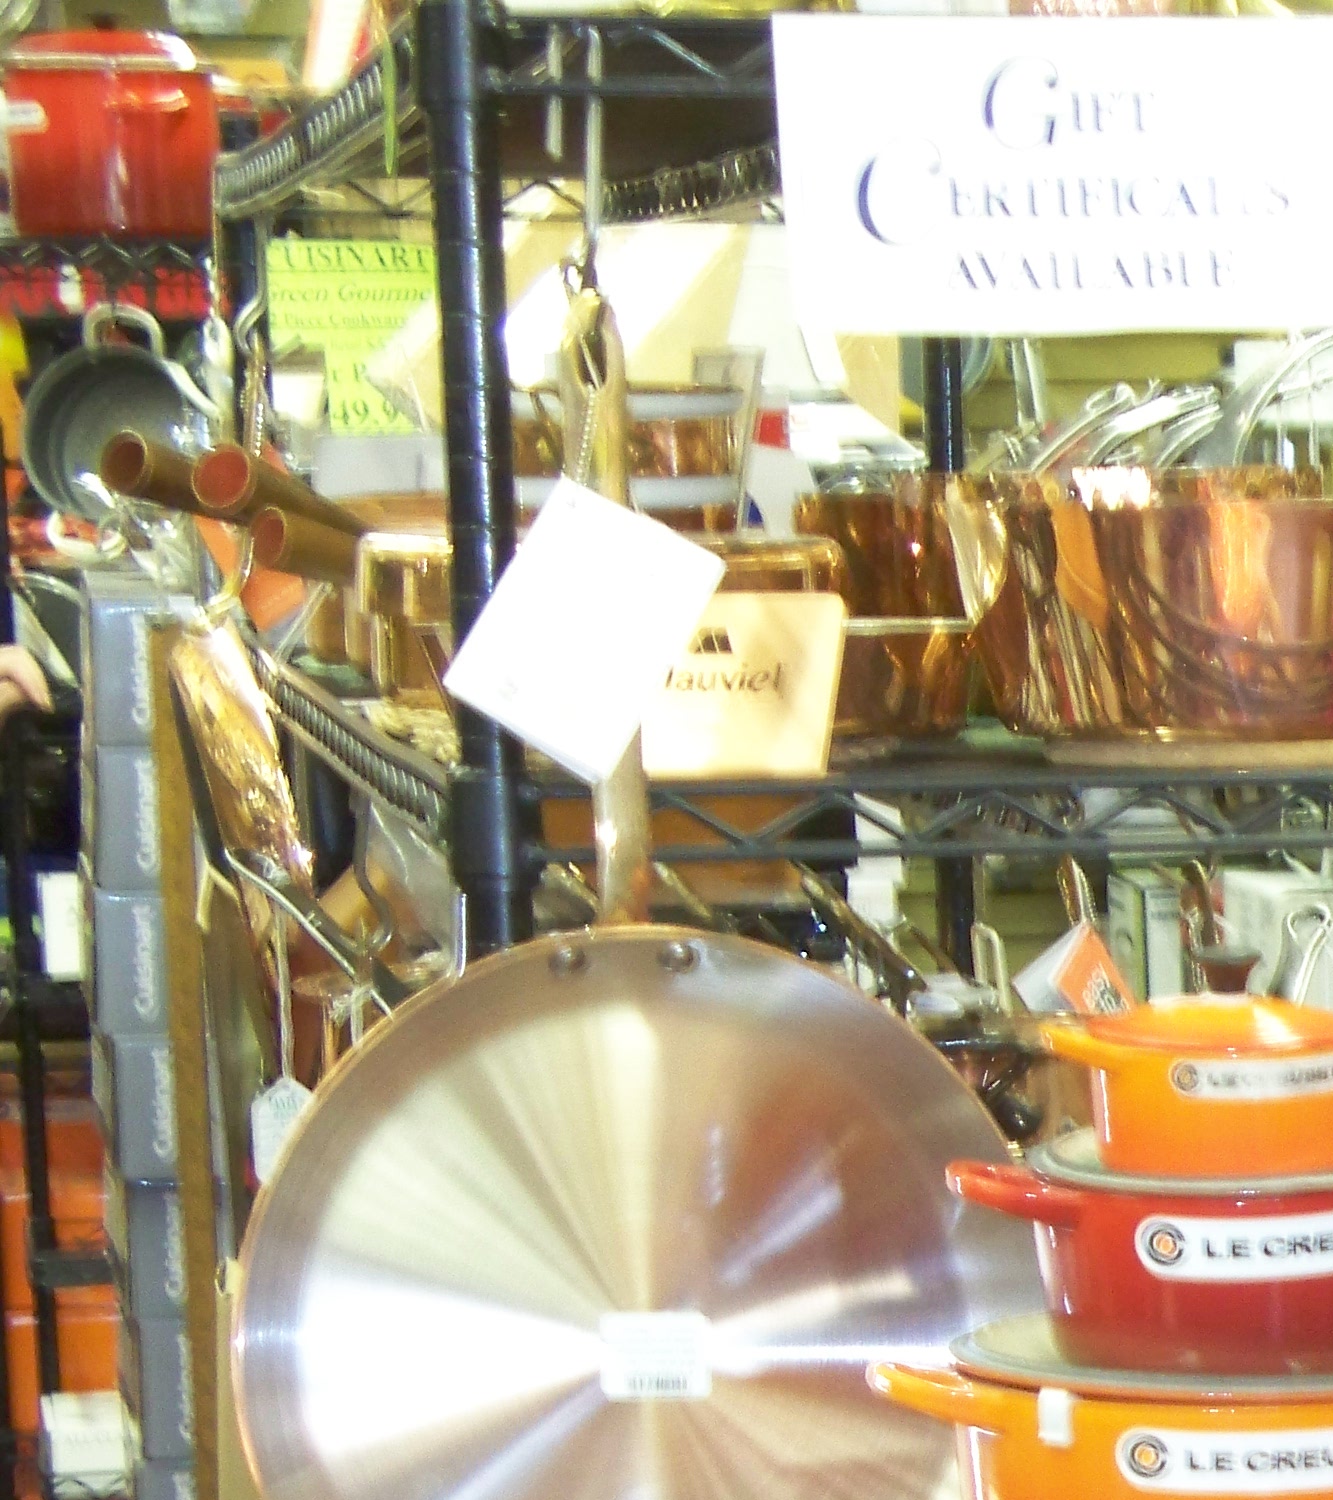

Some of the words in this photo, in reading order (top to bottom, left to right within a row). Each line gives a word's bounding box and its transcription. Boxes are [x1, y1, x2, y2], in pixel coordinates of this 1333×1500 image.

[982, 55, 1155, 149] GIFT
[855, 136, 1291, 246] CERTIFICATS
[948, 250, 1237, 291] AVAILABLE
[338, 283, 430, 301] Gourme
[329, 312, 408, 328] Cookwar
[663, 660, 784, 692] auviel
[134, 758, 157, 876] Cuisinart
[133, 904, 157, 1022] Cuisinart
[152, 1048, 174, 1164] Cuisinart
[1203, 1237, 1250, 1259] LE
[1187, 1449, 1235, 1473] LE
